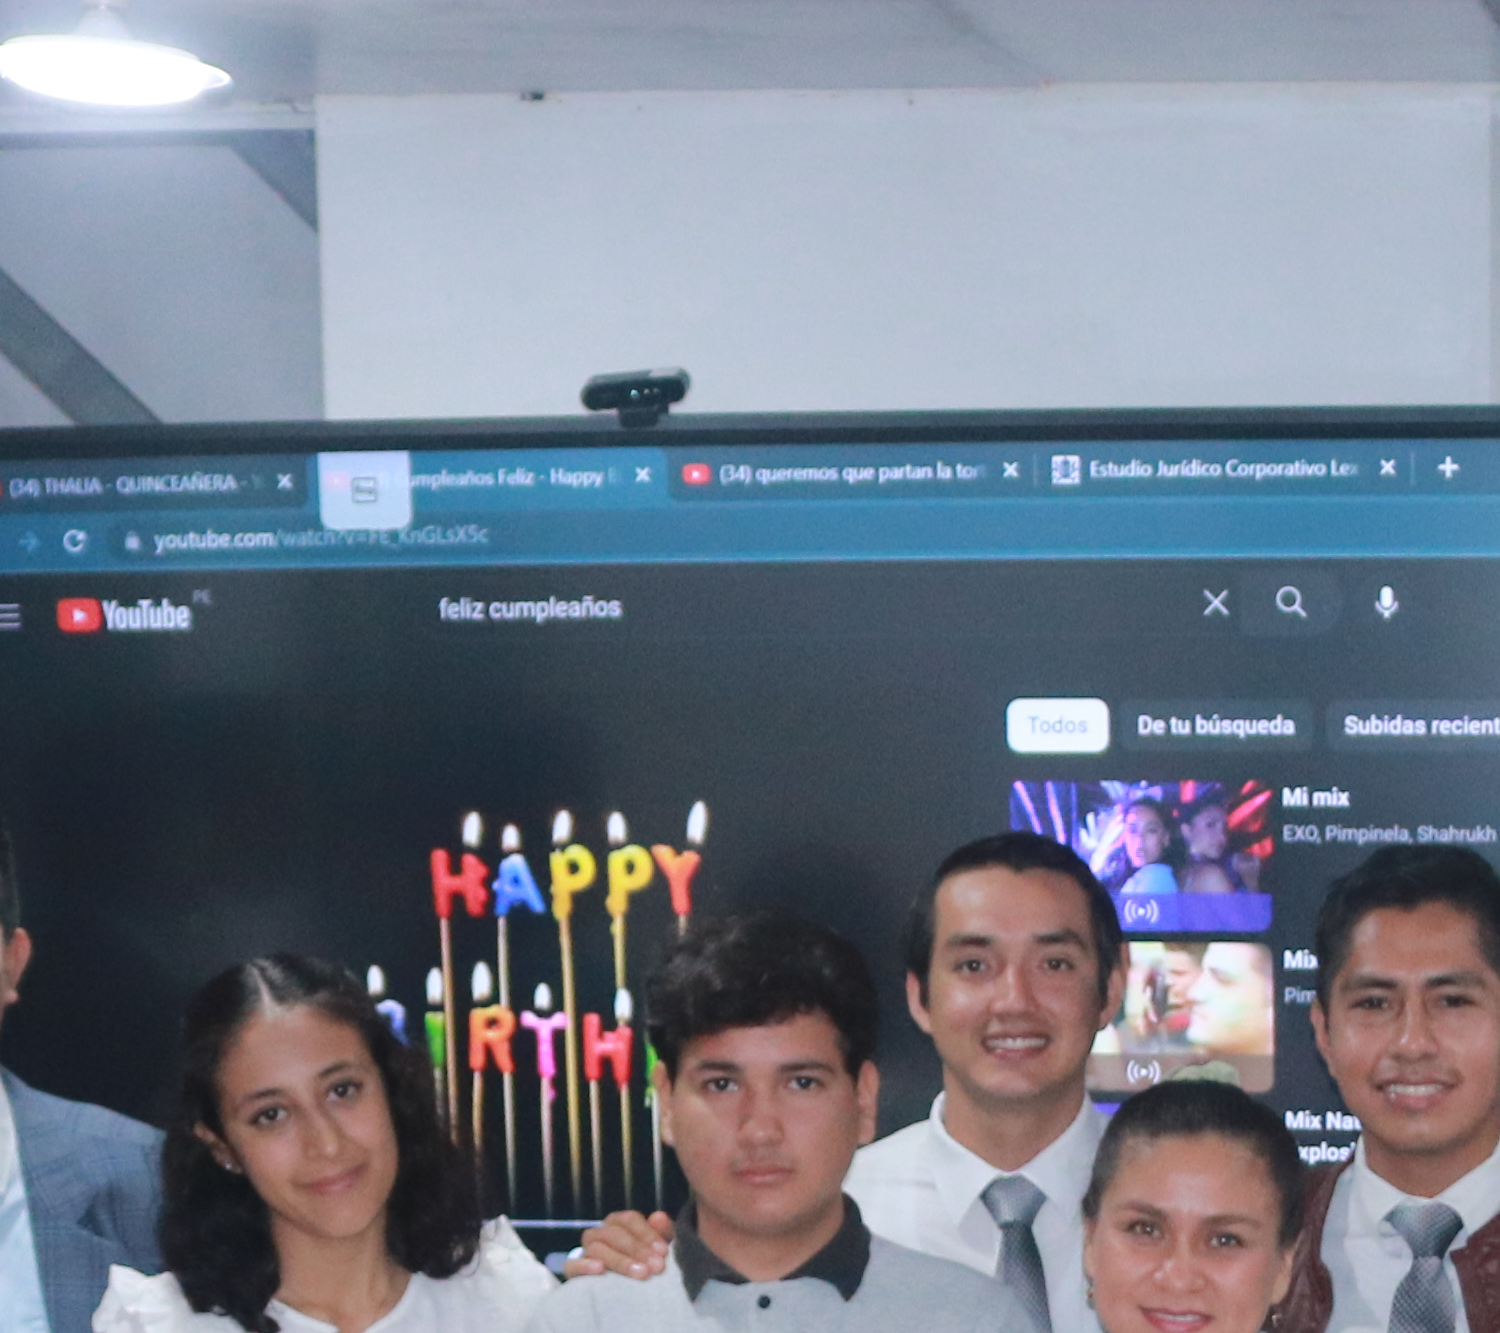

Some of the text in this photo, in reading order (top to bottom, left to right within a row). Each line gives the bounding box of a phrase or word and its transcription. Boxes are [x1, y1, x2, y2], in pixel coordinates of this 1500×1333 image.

[410, 468, 494, 491] umpleaños
[550, 468, 604, 489] Happy
[719, 463, 750, 485] (34)
[755, 466, 838, 485] queremos
[842, 465, 875, 485] que
[878, 464, 933, 485] partan
[937, 460, 952, 479] la
[1089, 458, 1153, 478] Estudio
[1156, 457, 1221, 478] Jurídico
[1225, 457, 1327, 482] Corporativo
[116, 471, 238, 495] QUINCEAÑERA
[101, 598, 191, 631] YouTube
[438, 594, 623, 622] feliz cumpleaños
[1028, 715, 1088, 735] Todos
[1137, 713, 1295, 741] De tu búsqueda
[1344, 714, 1426, 736] Subidas
[1282, 787, 1350, 807] Mi mix
[1282, 825, 1321, 846] EXO,
[1325, 824, 1412, 847] Pimpinela,
[1417, 824, 1496, 844] Shahrukh
[430, 842, 700, 920] HAPPY
[1283, 949, 1318, 970] Mix
[1284, 1110, 1322, 1131] Mix
